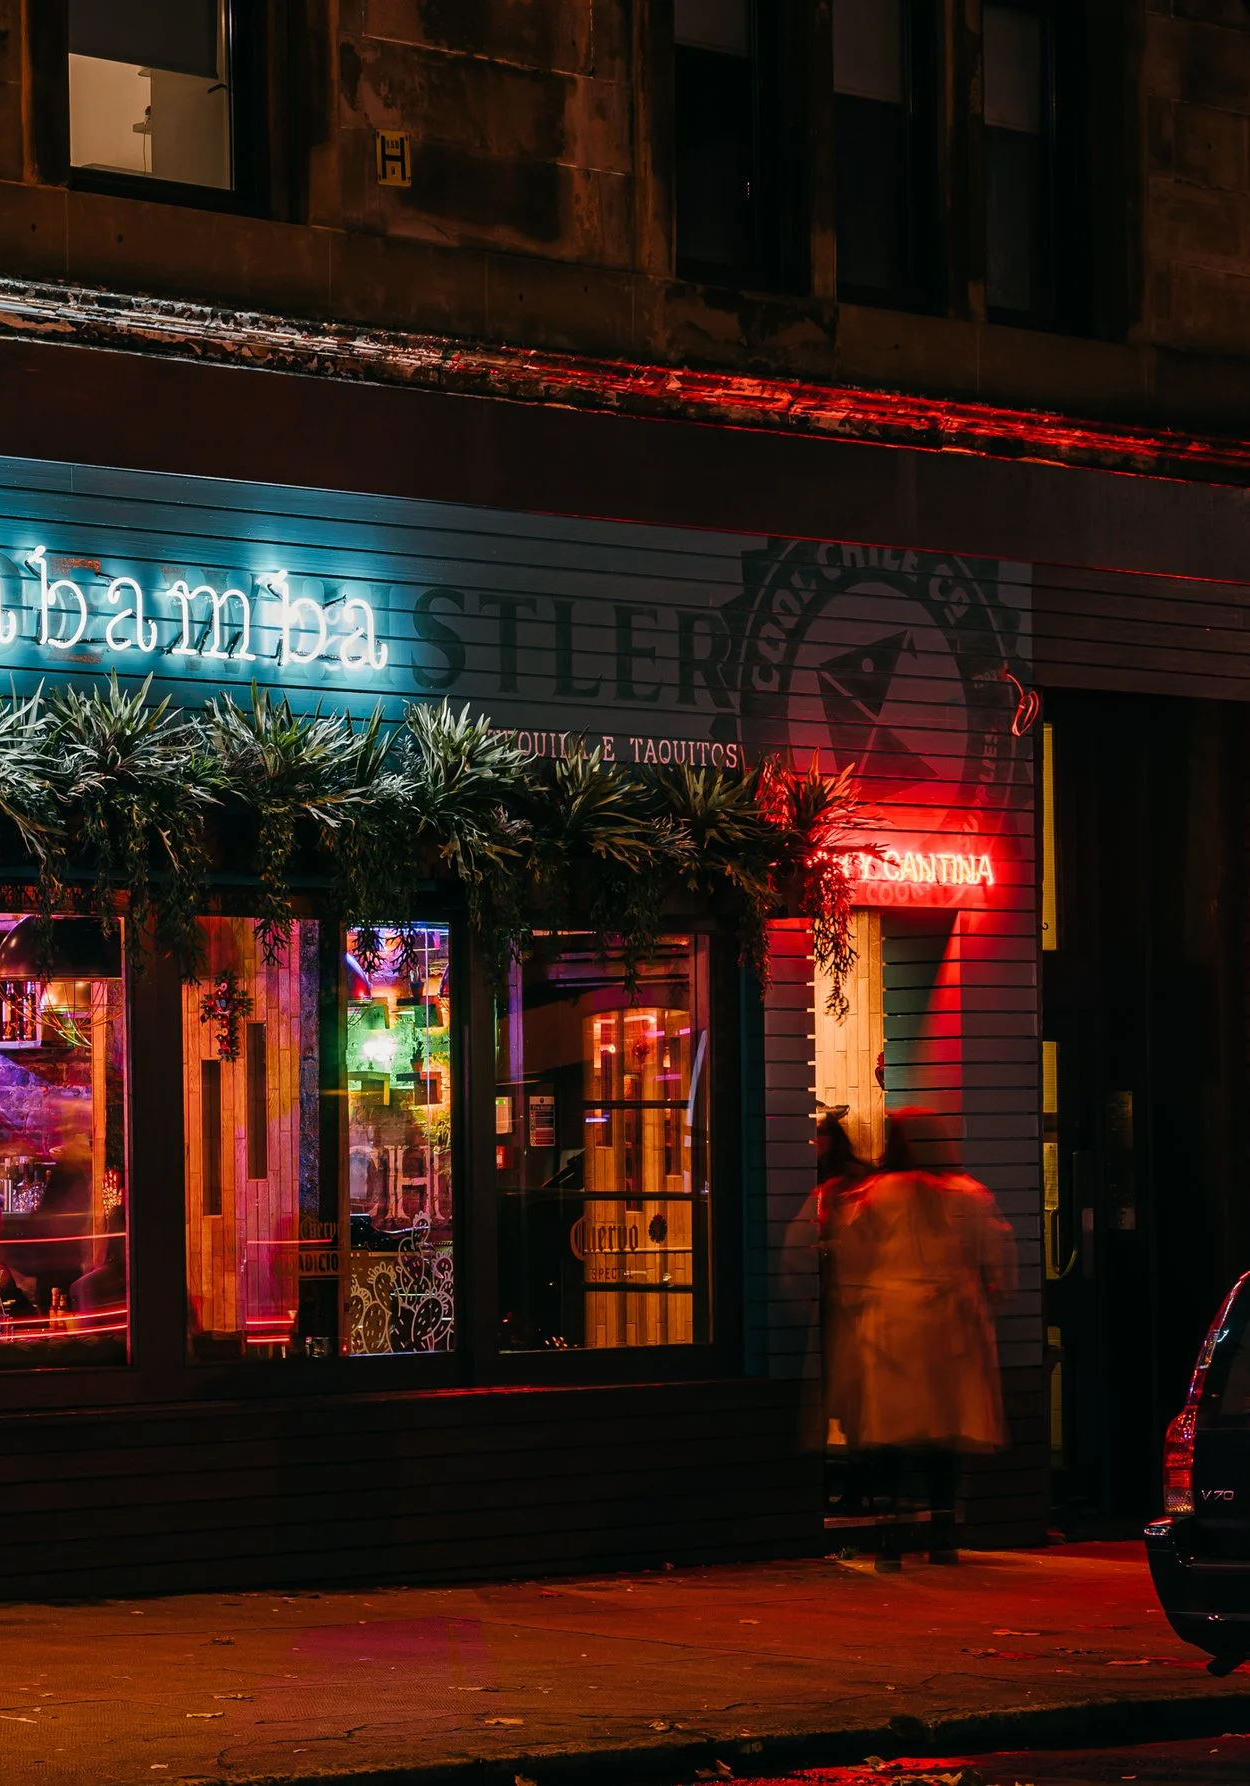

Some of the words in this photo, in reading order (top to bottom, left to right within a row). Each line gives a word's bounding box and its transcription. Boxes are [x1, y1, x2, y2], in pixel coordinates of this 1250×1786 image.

[381, 135, 407, 182] H
[487, 727, 595, 763] QUIL
[630, 737, 739, 771] TAQUITOS
[881, 849, 996, 887] CANTINA
[570, 1215, 640, 1262] Cuervo
